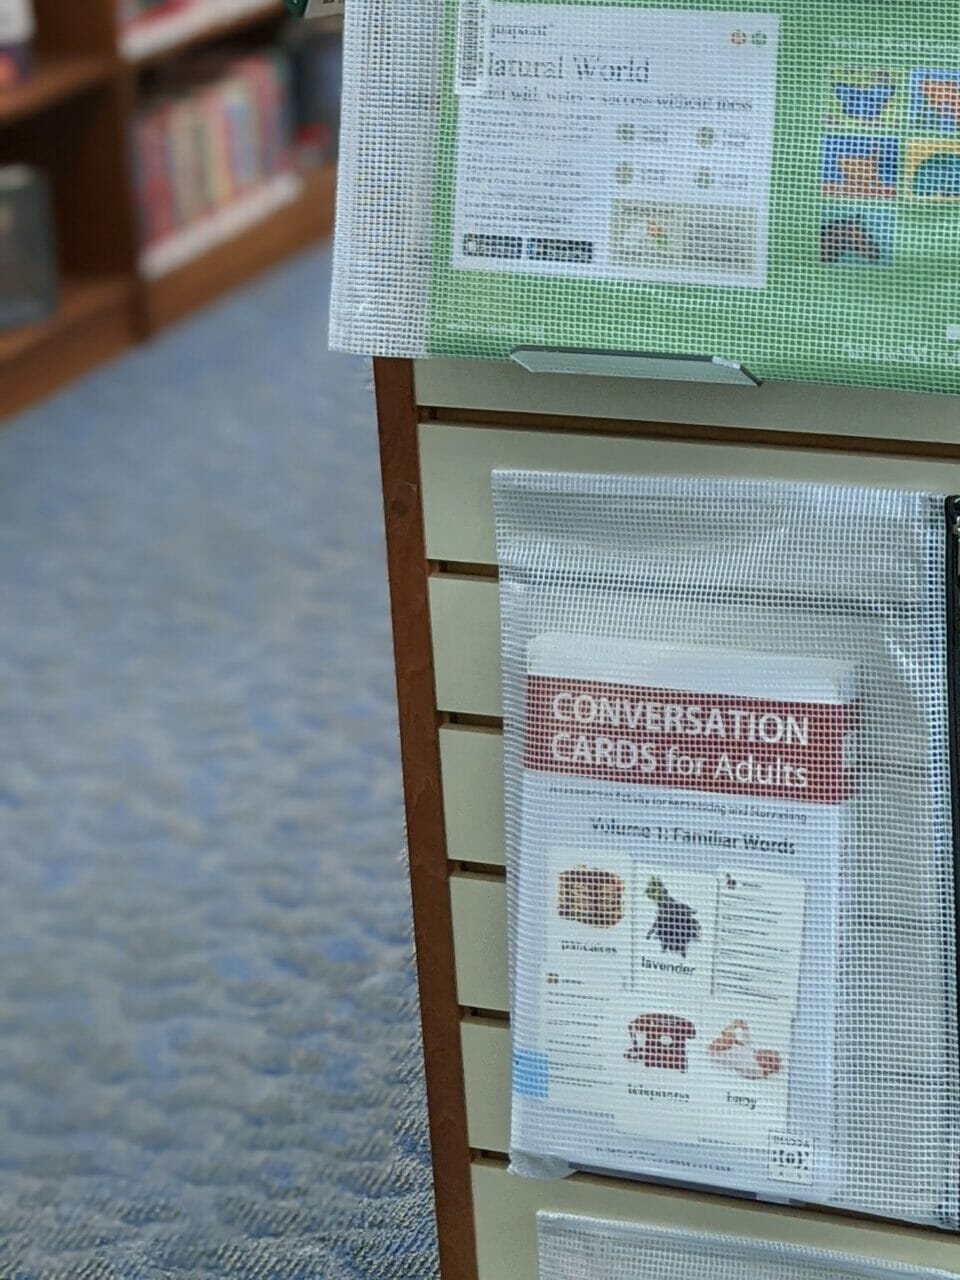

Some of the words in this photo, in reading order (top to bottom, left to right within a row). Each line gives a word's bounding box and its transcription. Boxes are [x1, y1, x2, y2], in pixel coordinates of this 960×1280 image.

[489, 51, 564, 80] atural
[573, 54, 651, 83] World
[551, 691, 809, 746] CONVERSATION
[551, 731, 657, 772] CARDS
[665, 745, 705, 775] for
[714, 753, 808, 787] Adults
[592, 817, 651, 839] Volume
[673, 827, 741, 850] Familiar
[743, 831, 796, 856] Words
[640, 956, 696, 977] lavender
